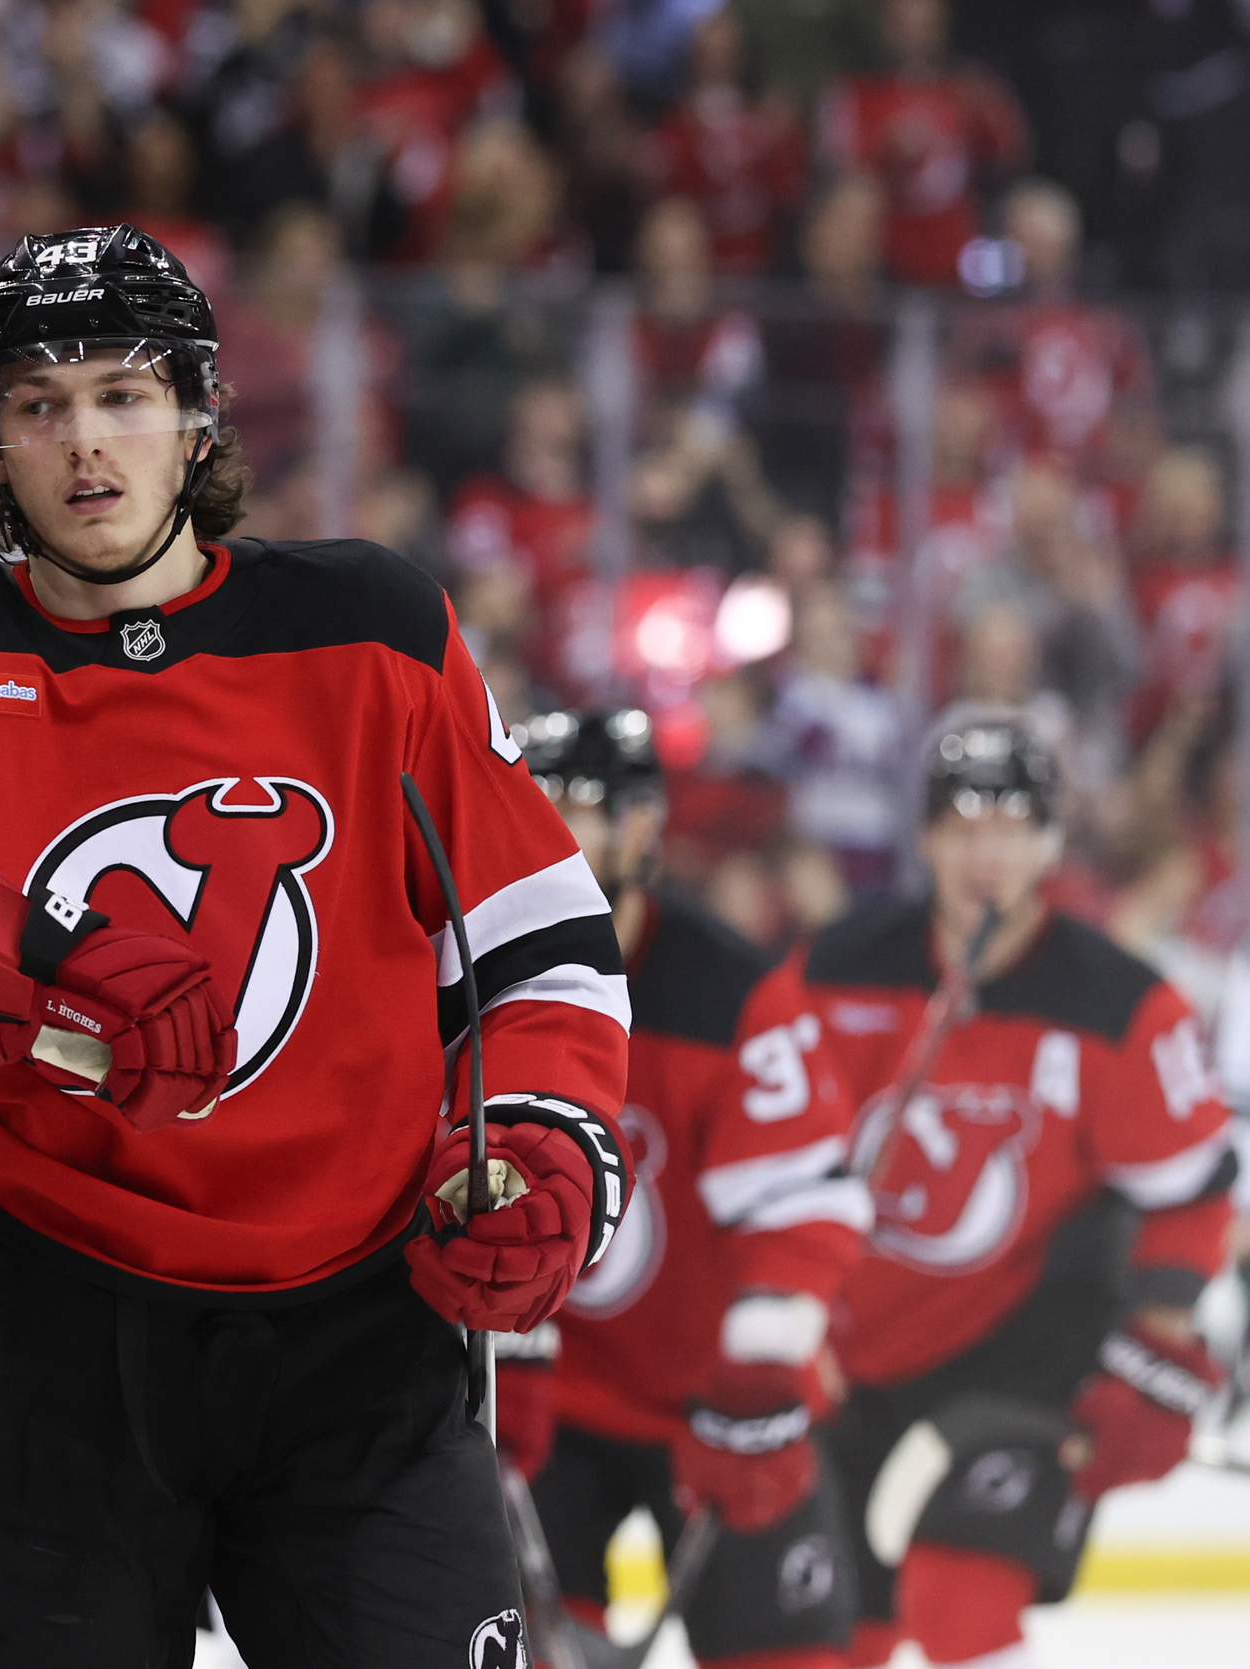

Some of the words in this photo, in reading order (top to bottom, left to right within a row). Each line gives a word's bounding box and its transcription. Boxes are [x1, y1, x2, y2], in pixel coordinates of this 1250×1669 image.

[36, 241, 98, 266] 43
[26, 288, 105, 307] BAUER
[132, 630, 155, 655] NHL
[45, 999, 56, 1013] L.
[57, 1004, 103, 1034] HUGHES
